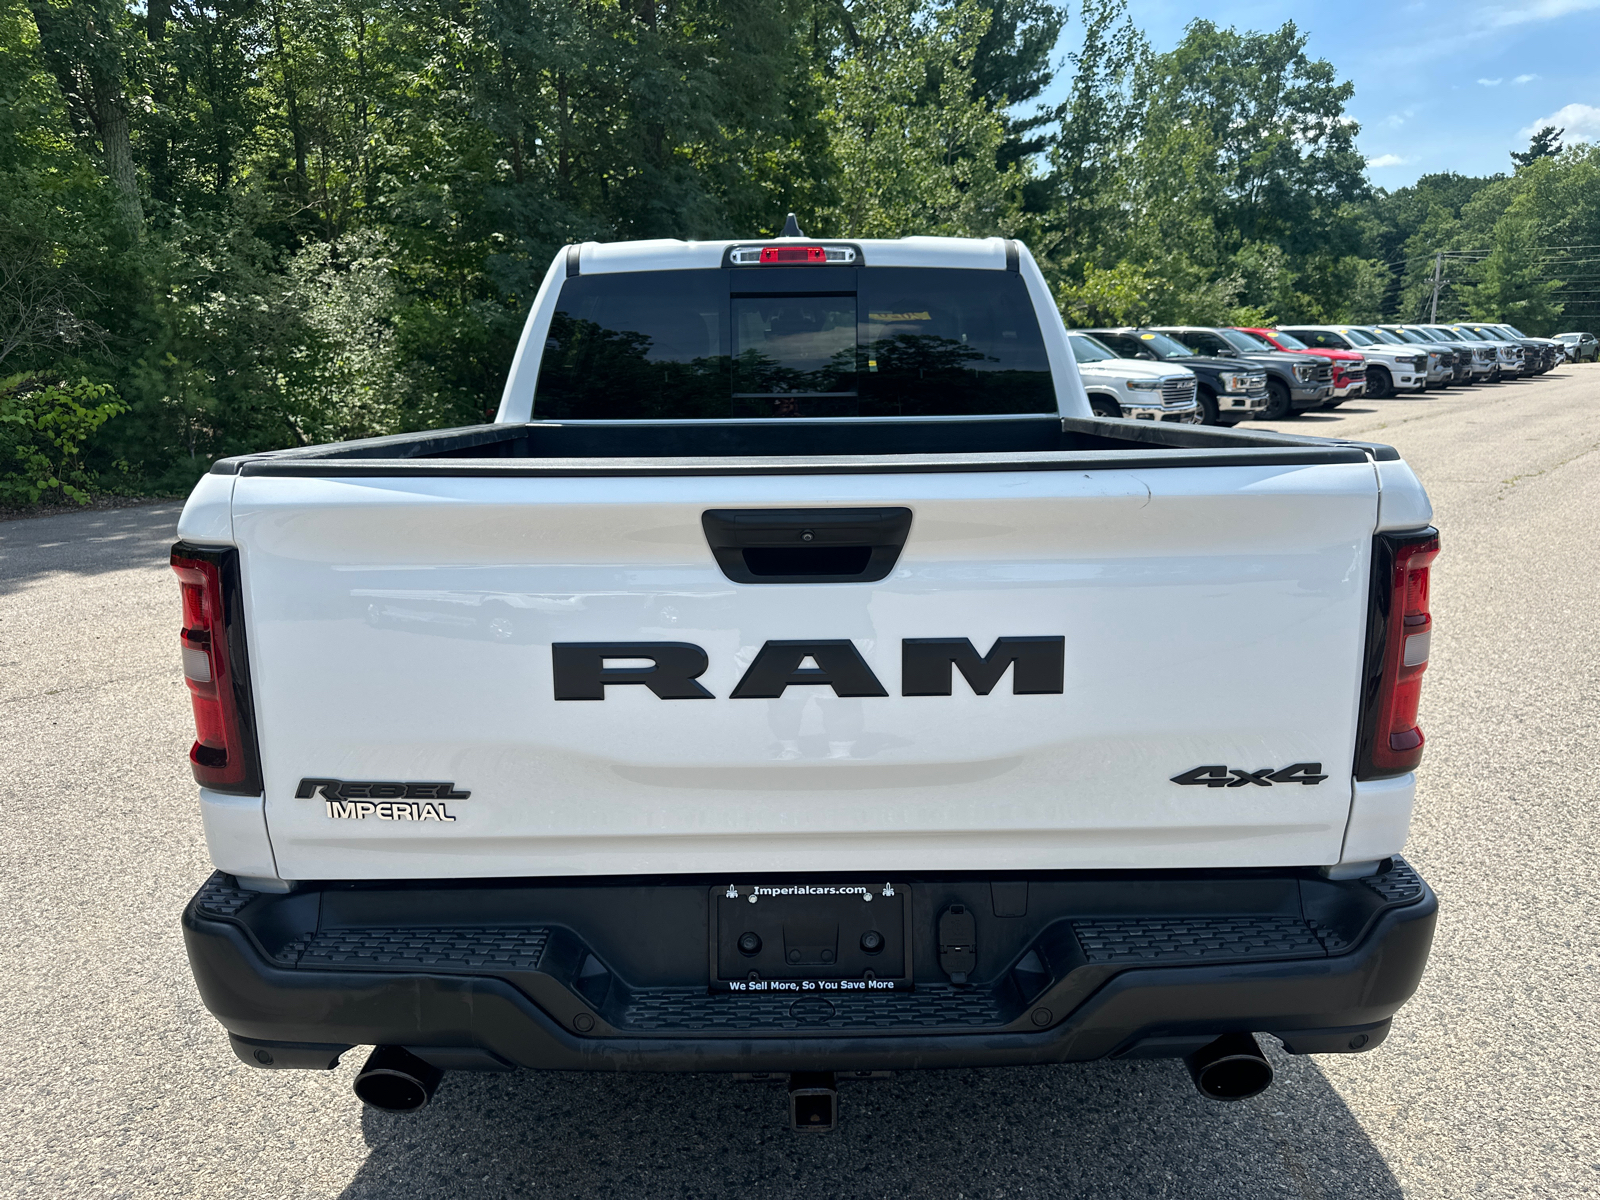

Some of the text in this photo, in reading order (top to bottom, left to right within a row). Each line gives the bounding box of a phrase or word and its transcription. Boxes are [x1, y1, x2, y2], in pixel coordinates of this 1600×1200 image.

[552, 635, 1065, 701] RAM
[295, 777, 472, 801] REBEL
[325, 801, 456, 822] IMPERIAL
[753, 885, 867, 896] Imperialcars.com
[729, 980, 894, 991] We Sell More, So You Save More
